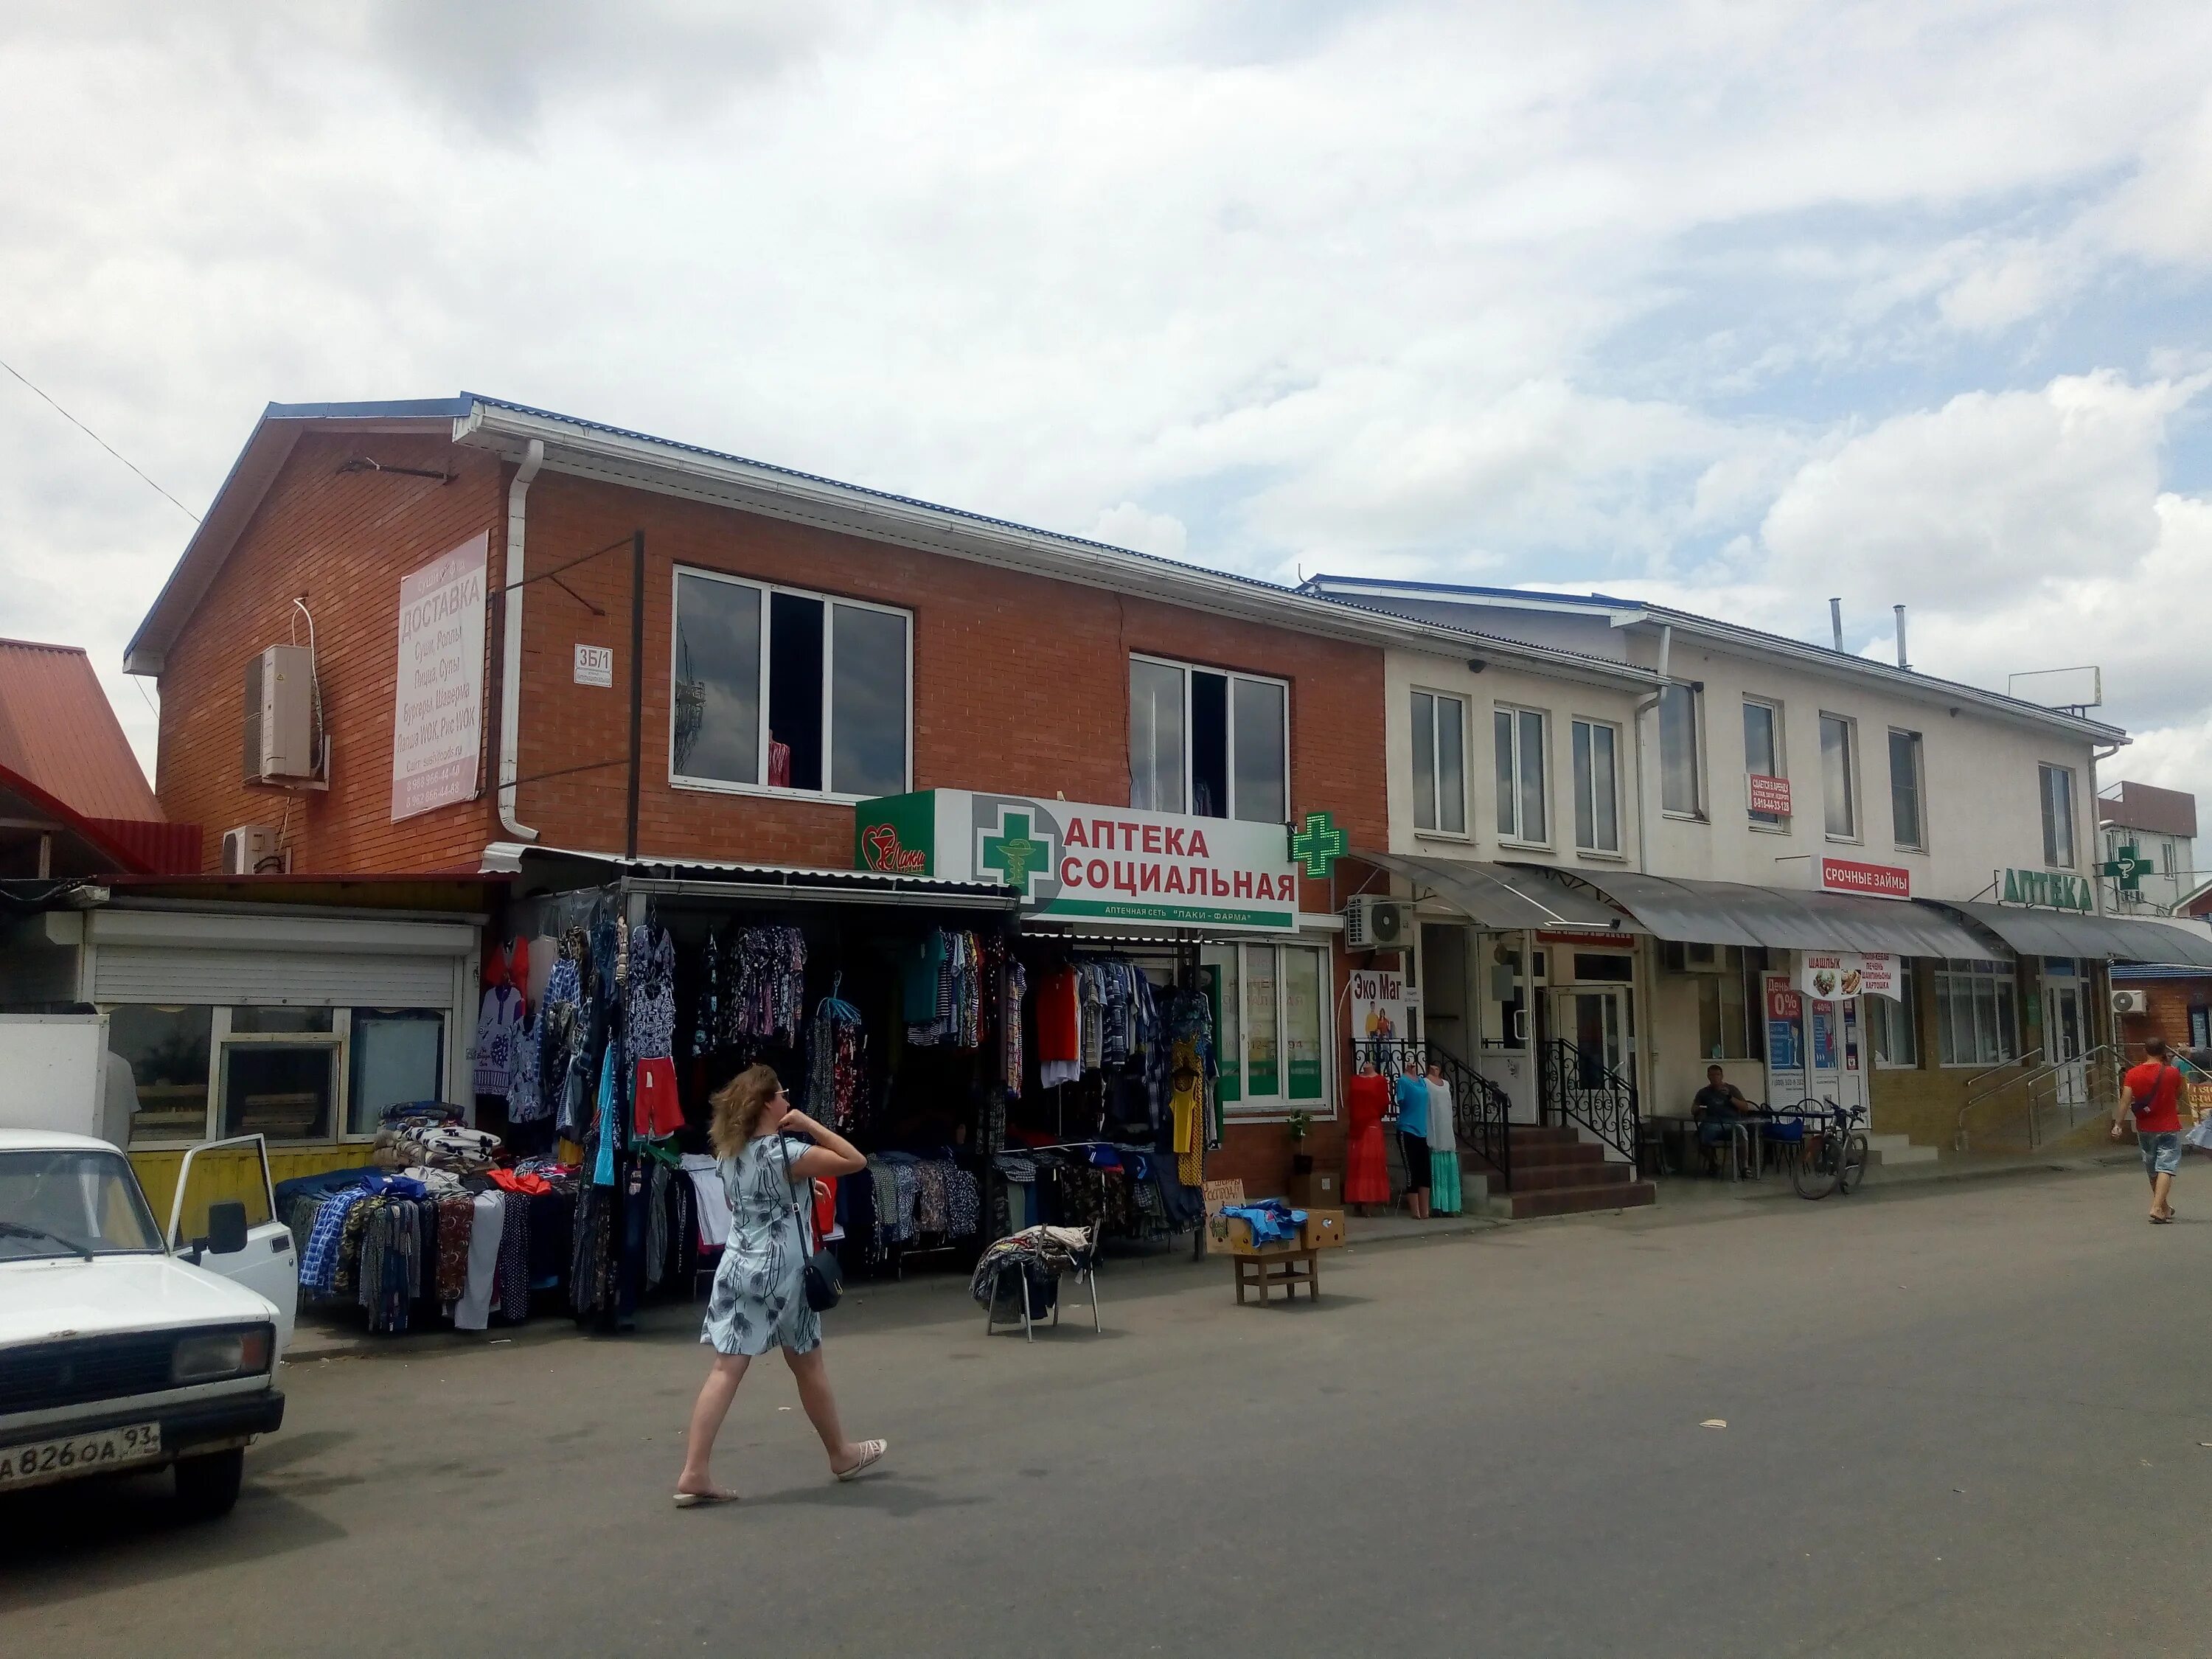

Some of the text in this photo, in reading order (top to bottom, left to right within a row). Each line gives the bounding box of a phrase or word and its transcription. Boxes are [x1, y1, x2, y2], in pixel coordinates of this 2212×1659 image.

[402, 575, 480, 644] ДОСТАВКА
[437, 626, 462, 650] Роллы
[440, 656, 459, 682] Супы
[580, 649, 608, 668] 3Б/1
[437, 683, 470, 709] Шаверма
[441, 717, 455, 737] Рис
[456, 706, 475, 731] WOK
[1062, 817, 1209, 858] АПТЕКА
[1060, 856, 1295, 902] СОЦИАЛЬНАЯ
[1825, 867, 1907, 890] СРОЧНЫЕ ЗАЙМЫ
[2004, 868, 2093, 911] АПТЕКА
[1105, 906, 1147, 916] АПТЕЧНАЯ
[1148, 908, 1166, 917] СЕТЬ
[1809, 956, 1840, 970] ШАШЛЫК
[1865, 961, 1883, 970] ПЕЧЕНЬ
[1354, 973, 1402, 1000] Эко Маг
[1865, 981, 1890, 990] КАРТОШКА
[1774, 992, 1797, 1015] 0%
[125, 1427, 151, 1449] 93
